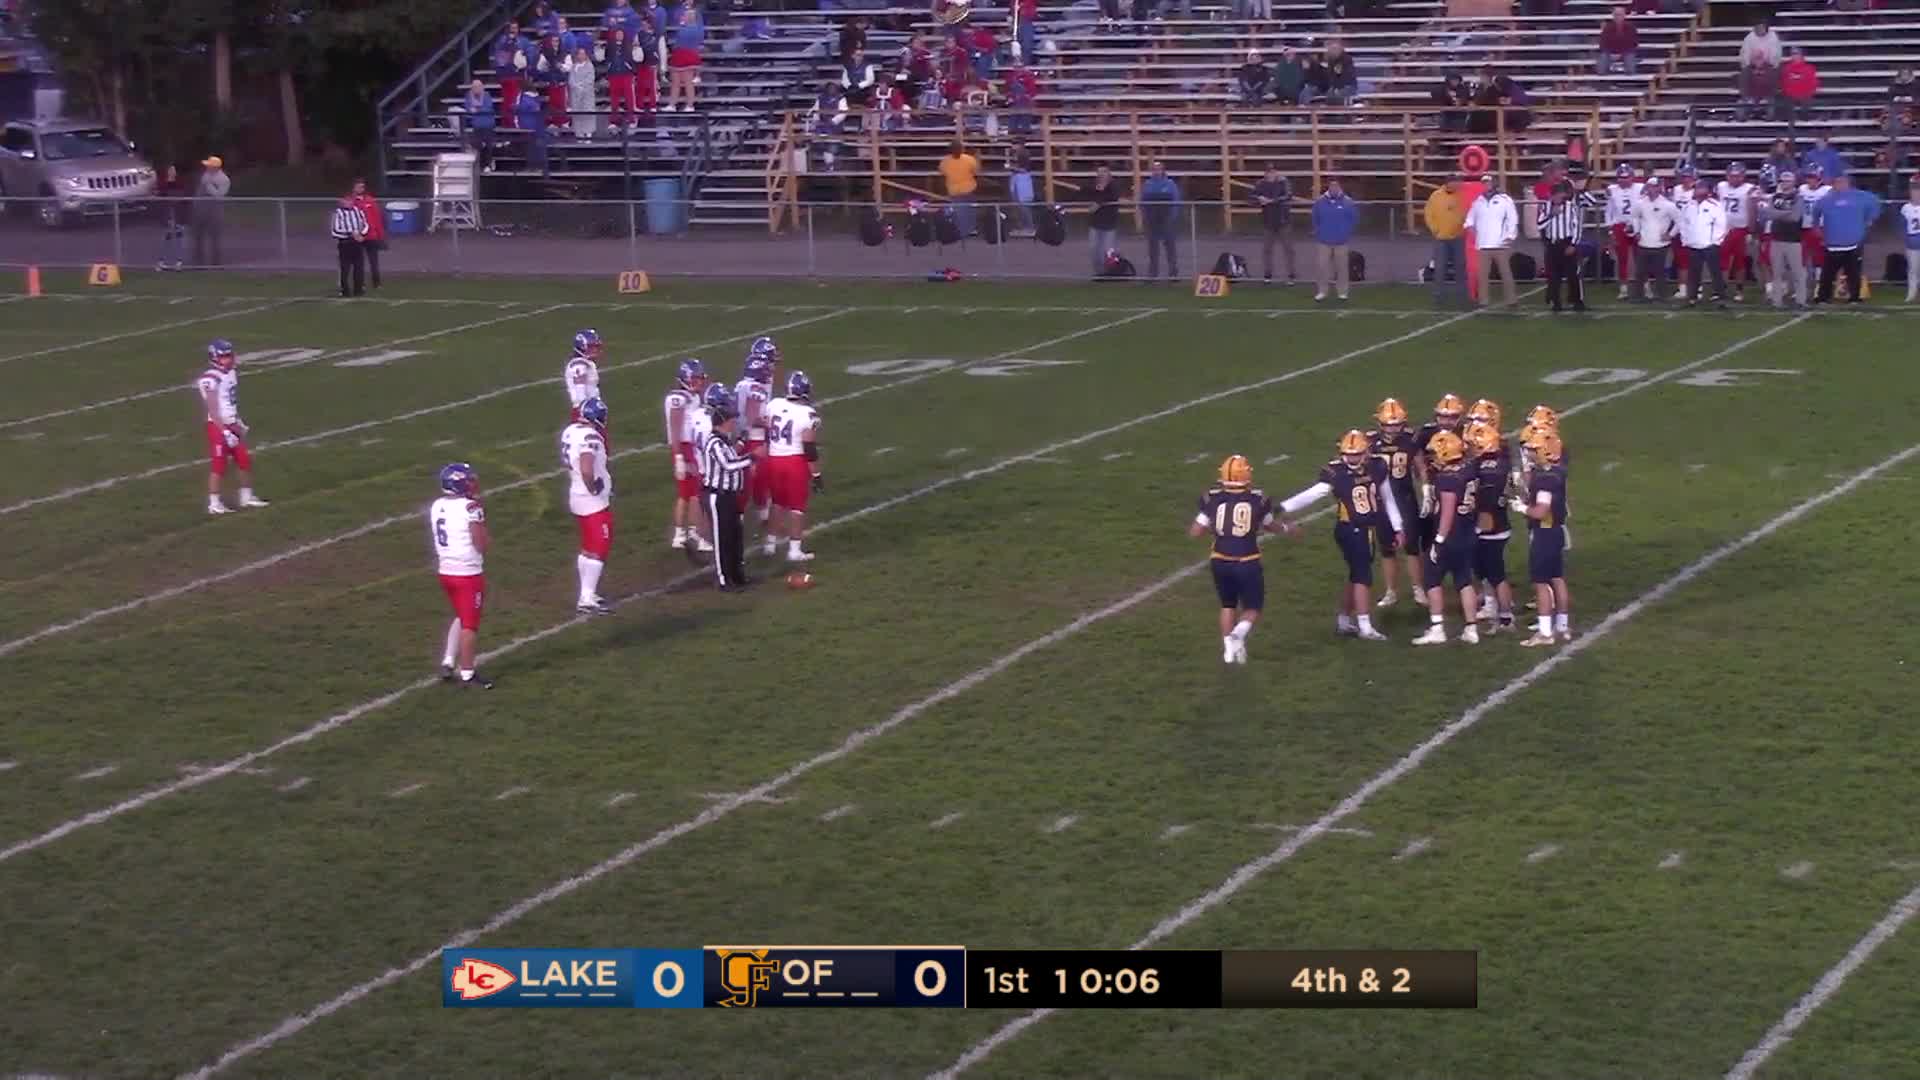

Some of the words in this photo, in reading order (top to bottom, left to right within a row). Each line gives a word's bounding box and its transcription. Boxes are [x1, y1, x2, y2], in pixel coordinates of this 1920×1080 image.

[1622, 199, 1632, 215] 2
[623, 273, 641, 290] 10
[1199, 277, 1221, 295] 20
[1215, 502, 1253, 538] 19
[436, 518, 449, 548] 6
